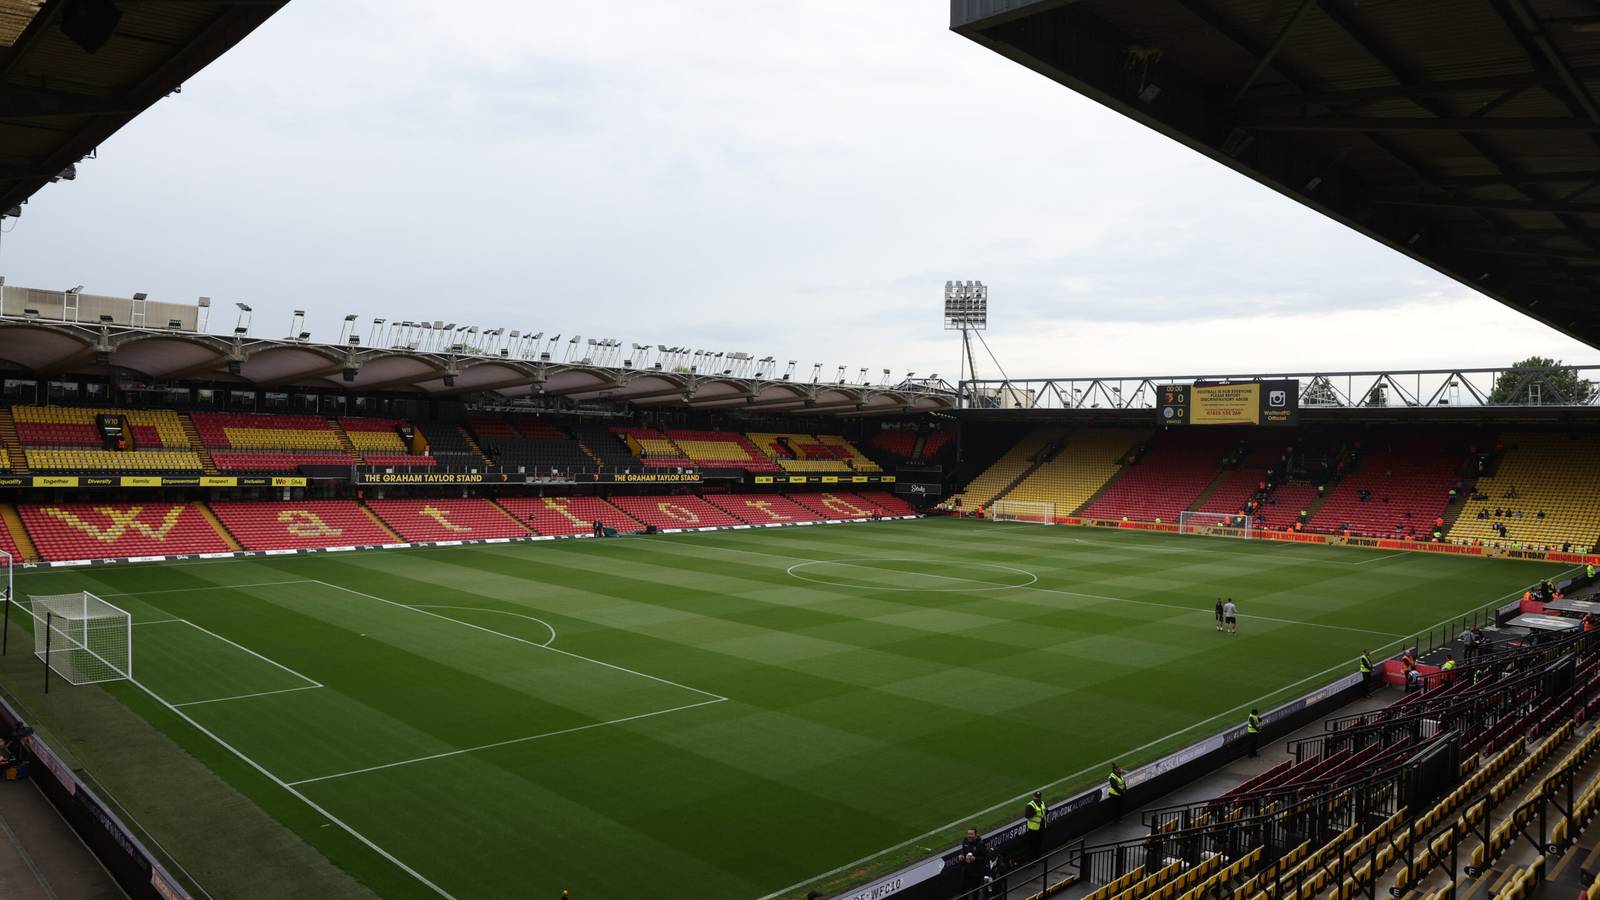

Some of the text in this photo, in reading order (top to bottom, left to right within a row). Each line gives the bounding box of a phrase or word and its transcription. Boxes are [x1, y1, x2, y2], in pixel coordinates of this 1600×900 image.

[1177, 394, 1184, 403] 0
[1177, 408, 1184, 417] 0
[365, 474, 483, 482] THE GRAHAM TAYLOR STAND
[614, 474, 700, 482] THE GRAHAM TAYLOR STAND
[1346, 538, 1359, 546] JOIN
[1359, 539, 1378, 547] TODAY
[1507, 550, 1522, 558] JOIN
[1523, 551, 1546, 560] TODAY
